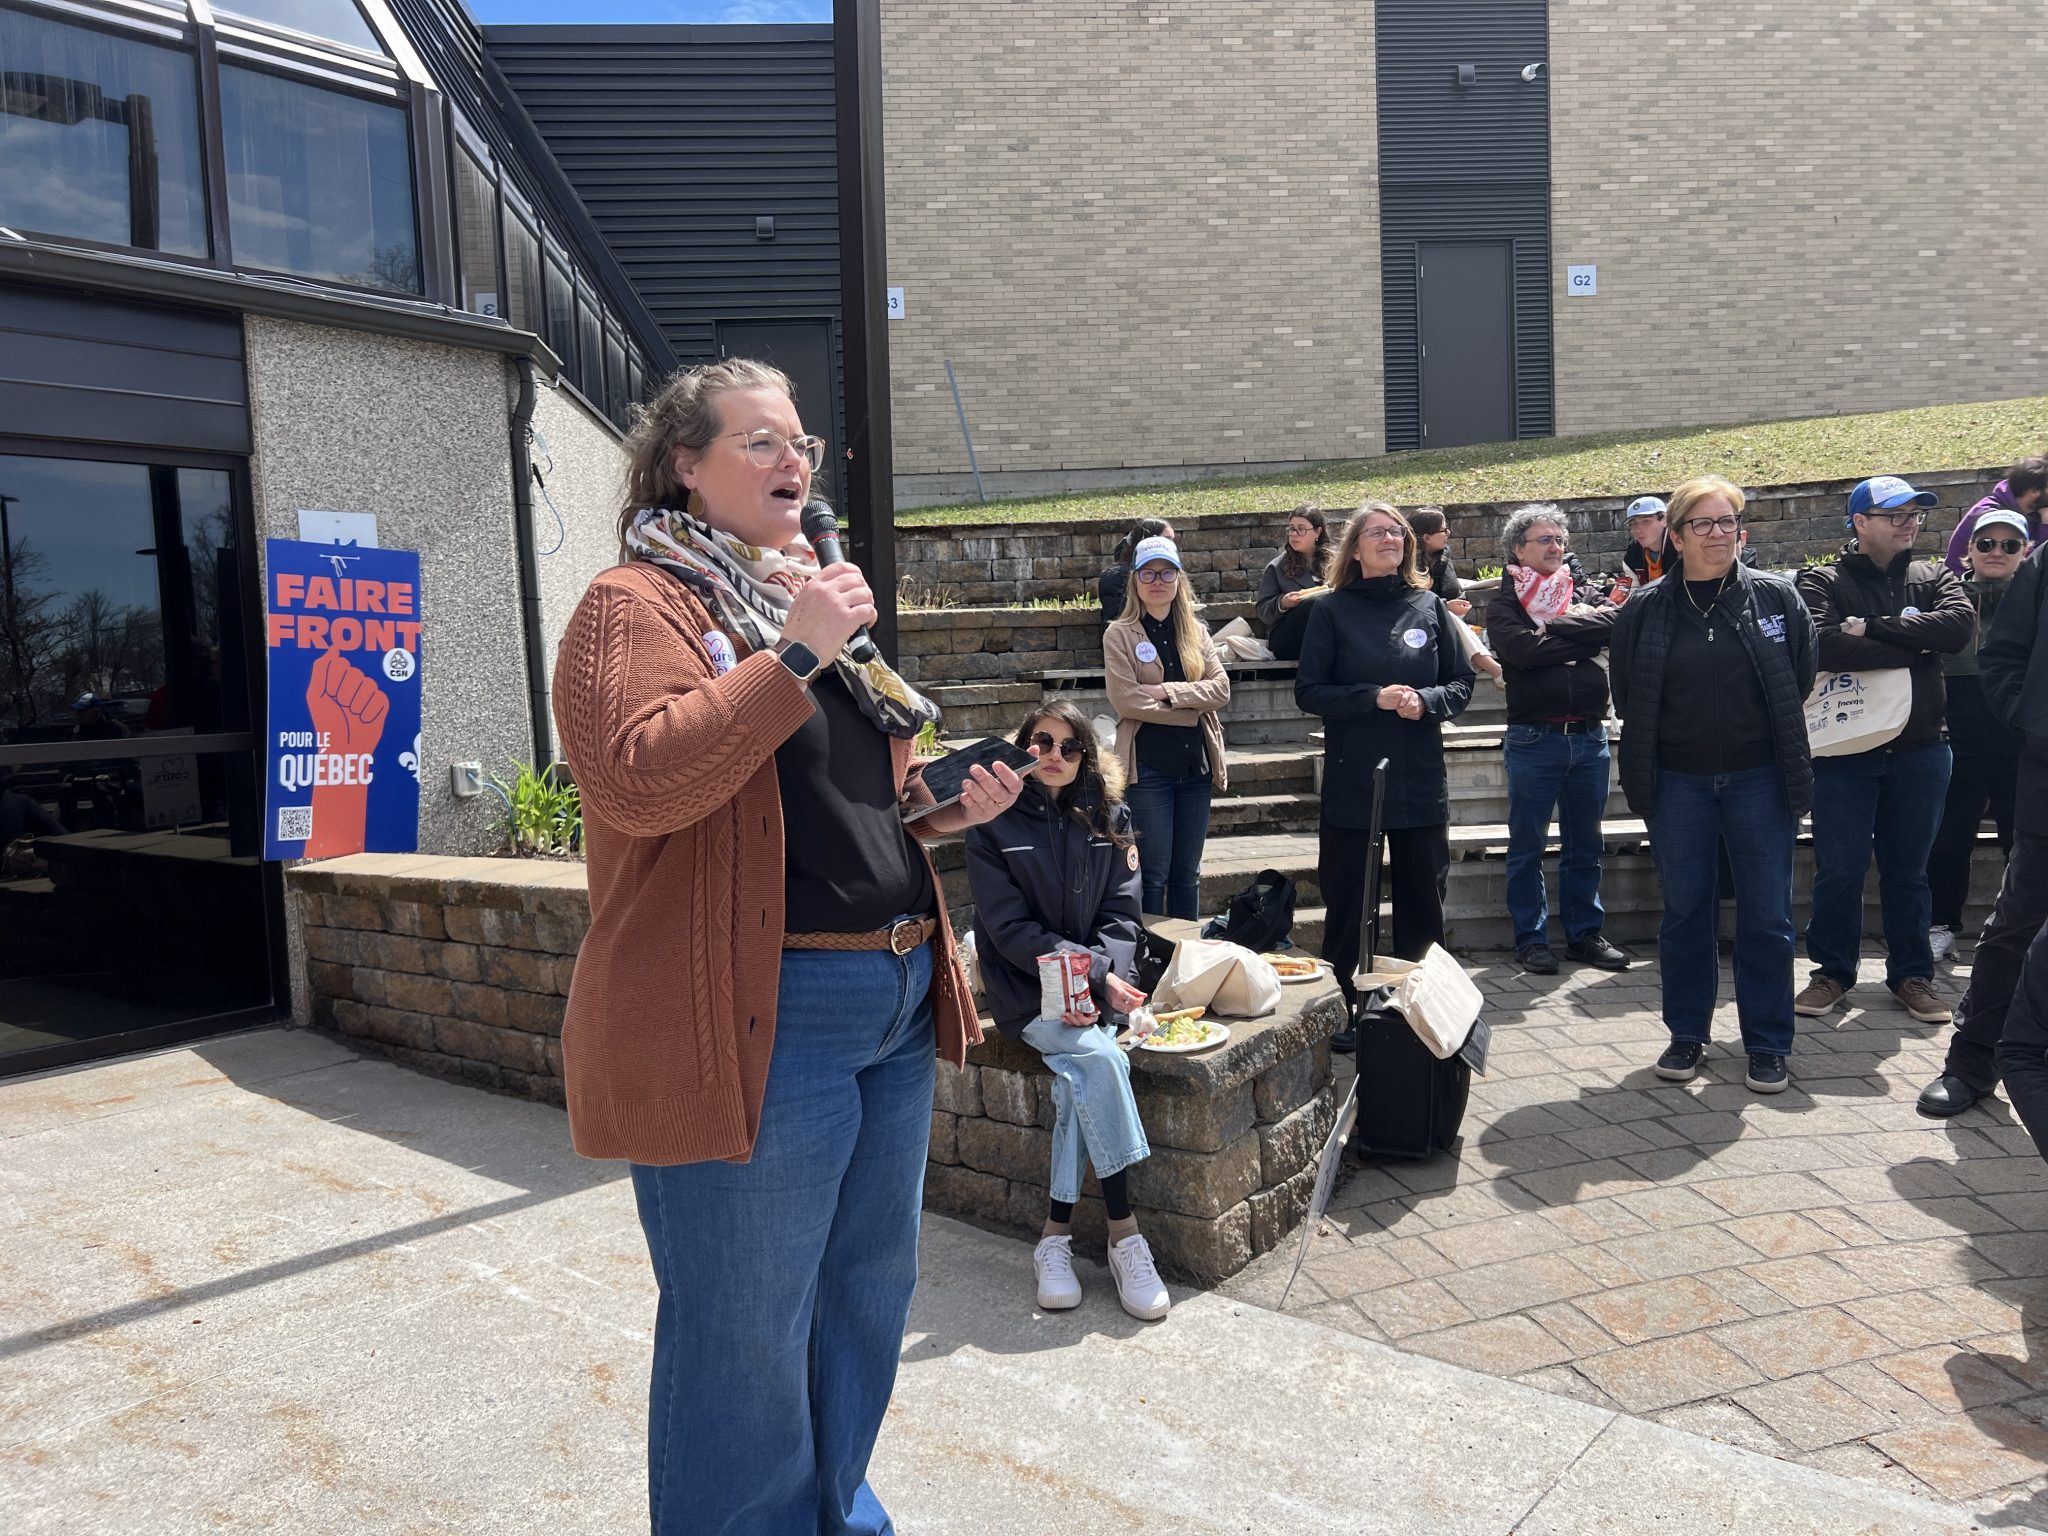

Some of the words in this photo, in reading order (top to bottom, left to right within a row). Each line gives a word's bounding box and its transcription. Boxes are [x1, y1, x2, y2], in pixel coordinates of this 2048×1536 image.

[1573, 275, 1591, 286] G2
[887, 297, 898, 309] 3
[276, 573, 413, 615] FAIRE
[268, 613, 422, 653] FRONT
[713, 652, 734, 662] urs
[390, 669, 408, 677] CSN
[280, 731, 313, 748] POUR
[316, 732, 331, 748] LE
[280, 748, 374, 792] QUÉBEC
